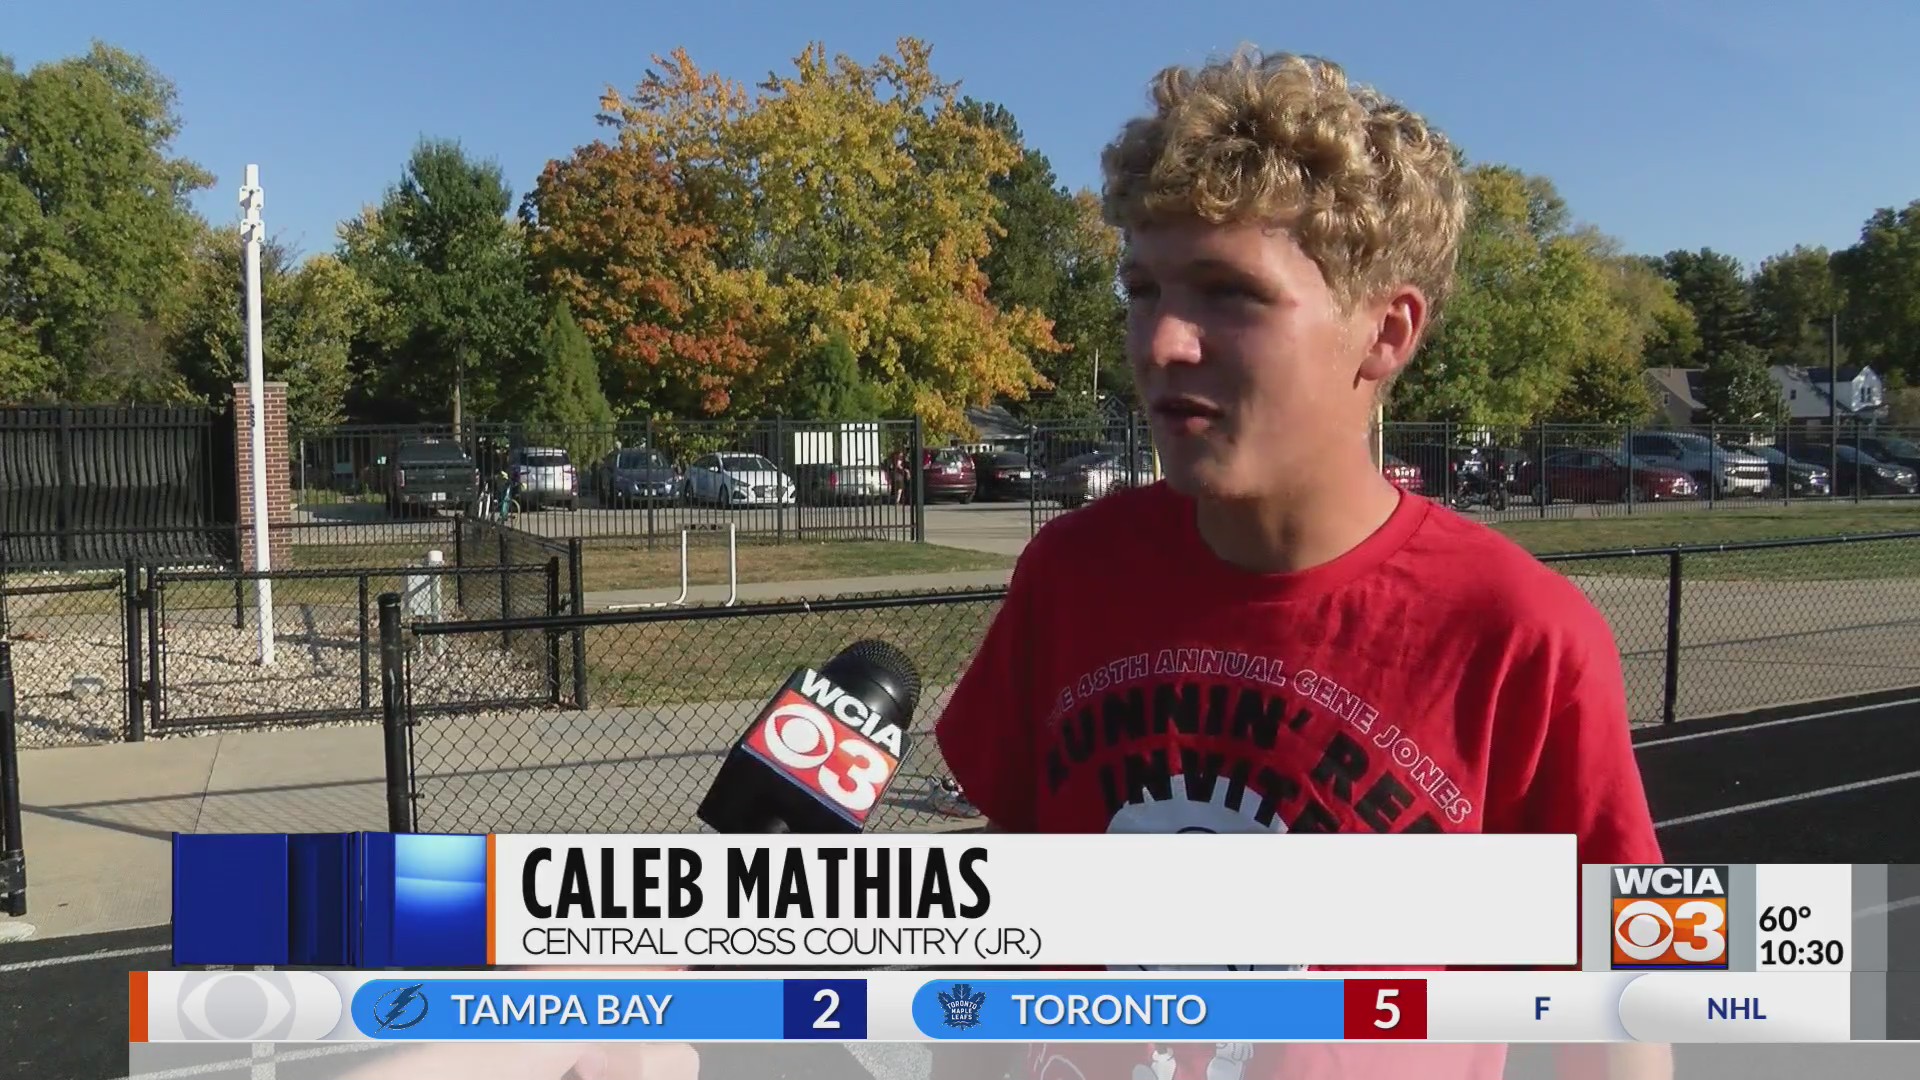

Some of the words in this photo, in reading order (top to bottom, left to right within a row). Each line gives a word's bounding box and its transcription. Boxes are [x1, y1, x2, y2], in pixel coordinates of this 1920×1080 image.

[800, 668, 902, 758] WCIA
[1077, 653, 1150, 698] 48TH
[1154, 648, 1287, 686] ANNUAL
[1293, 669, 1380, 734] GENE
[1373, 724, 1474, 825] JONES
[818, 739, 889, 812] 3
